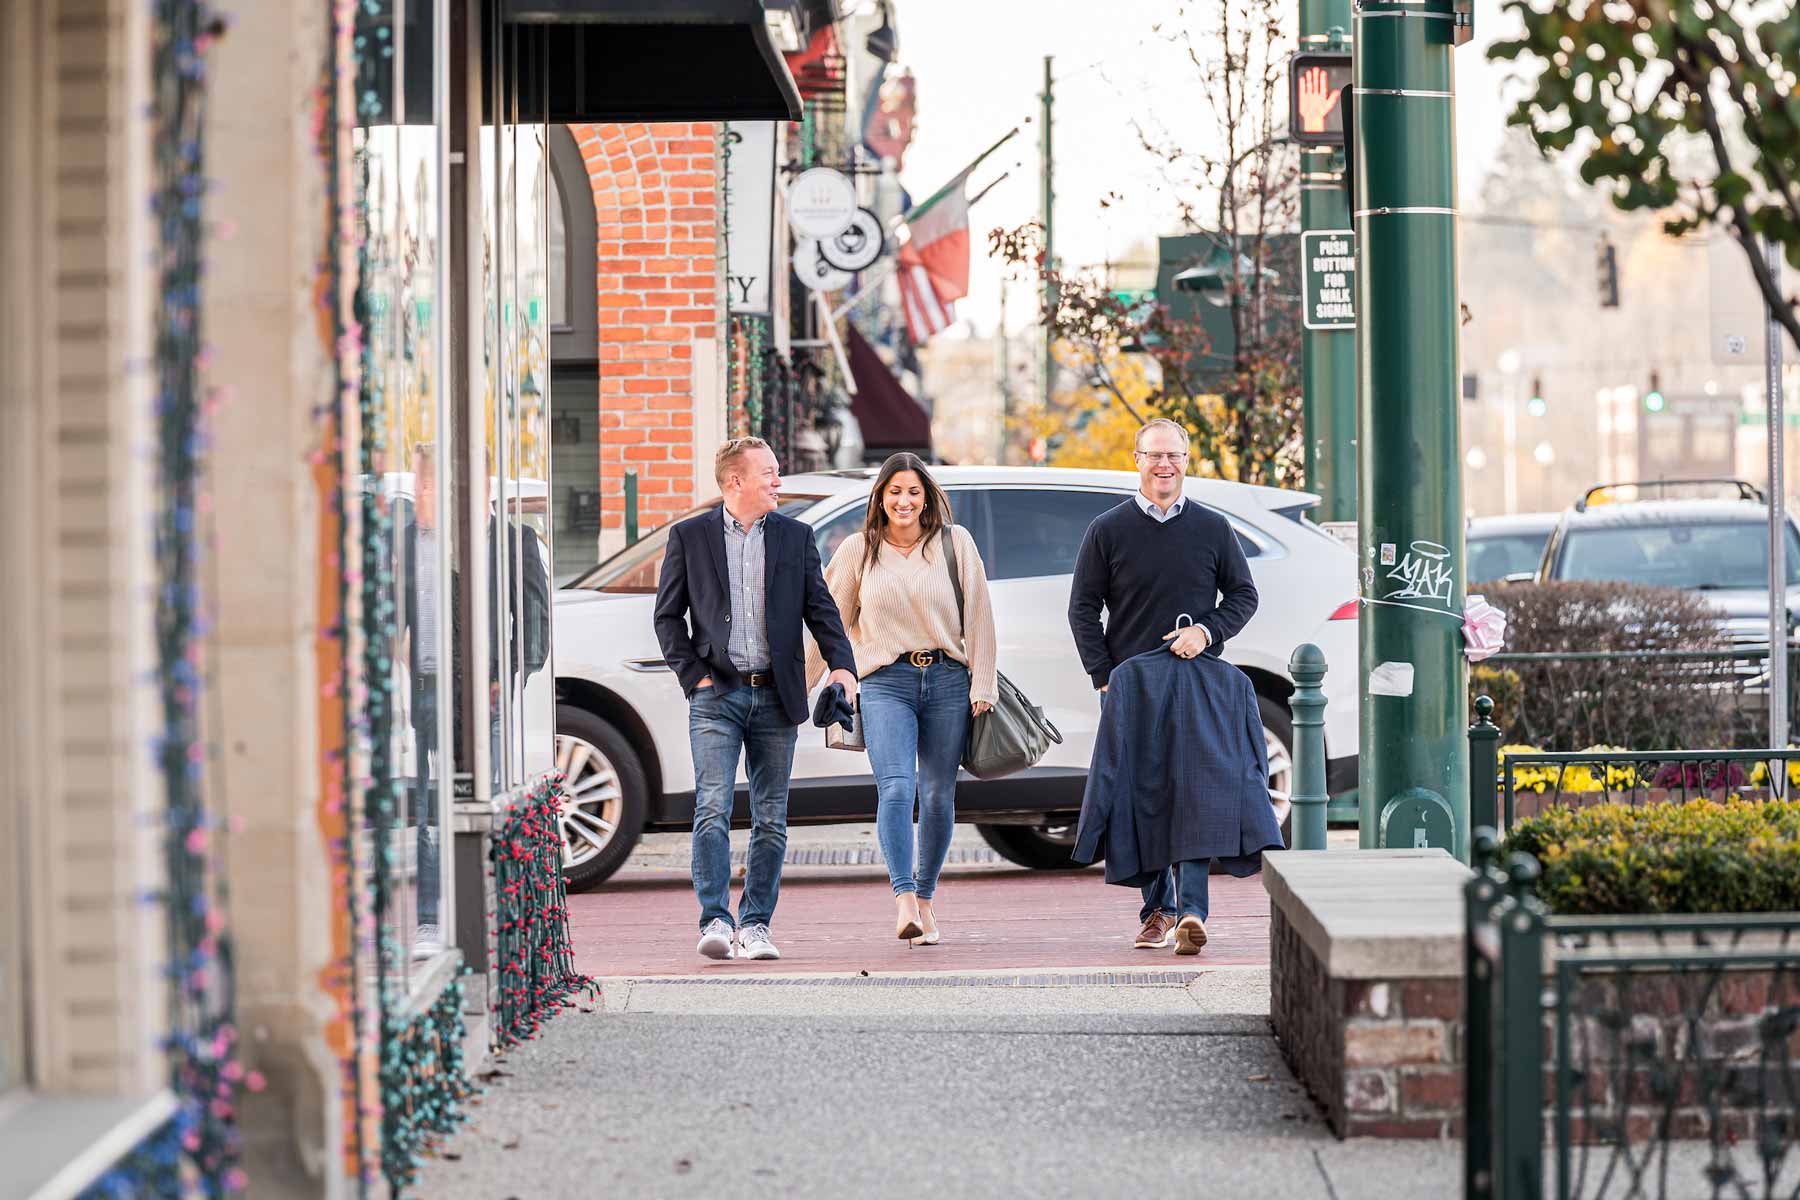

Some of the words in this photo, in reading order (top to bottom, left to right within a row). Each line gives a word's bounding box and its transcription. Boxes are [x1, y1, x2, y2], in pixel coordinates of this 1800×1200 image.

[1319, 240, 1348, 255] PUSH
[1324, 273, 1346, 288] FOR
[1320, 288, 1351, 303] WALK
[1316, 303, 1355, 318] SIGNAL
